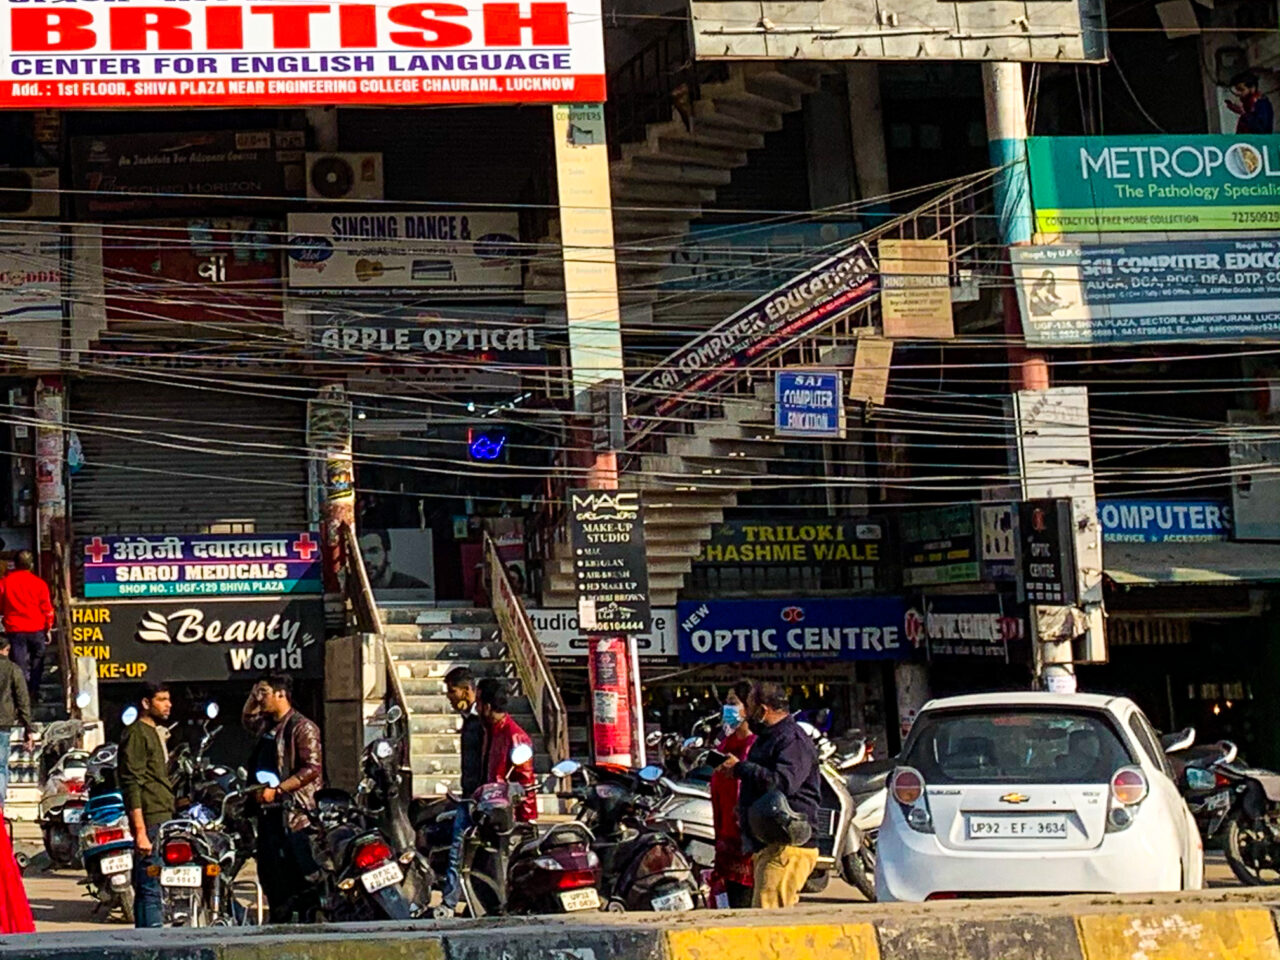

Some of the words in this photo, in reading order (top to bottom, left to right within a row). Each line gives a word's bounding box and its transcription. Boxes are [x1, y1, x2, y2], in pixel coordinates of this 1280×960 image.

[10, 2, 569, 51] BRITISH
[11, 58, 141, 75] CENTER
[154, 57, 217, 74] FOR
[231, 56, 374, 73] ENGLISH
[389, 53, 572, 71] LANGUAGE
[135, 81, 176, 95] SHIVA
[181, 81, 224, 95] PLAZA
[229, 81, 265, 94] NEAR
[269, 80, 357, 94] ENGINEERING
[360, 79, 419, 93] COLLEGE
[506, 77, 574, 91] LUCKNOW
[1114, 184, 1144, 198] The
[1148, 183, 1220, 200] Pathology
[1046, 217, 1083, 226] CONTACT
[1102, 216, 1121, 225] FREE
[1123, 216, 1147, 225] HOME
[1150, 215, 1199, 224] COLLECTION
[1081, 259, 1113, 276] SAI
[1117, 253, 1220, 273] COMPUTER
[321, 328, 410, 351] APPLE
[423, 327, 541, 351] OPTICAL
[654, 369, 679, 391] SAI
[794, 375, 821, 386] SAI
[783, 390, 833, 407] COMPUTER
[572, 493, 639, 512] MAC
[1096, 504, 1233, 530] OMPUTERS
[583, 523, 633, 533] MAKE-UP
[742, 525, 844, 542] TRILOKI
[587, 533, 630, 543] STUDIO
[114, 538, 184, 561] अंग्रेजी
[191, 538, 288, 559] दवाखाना
[813, 543, 880, 561] WALE
[1031, 543, 1051, 557] OPTIC
[116, 565, 179, 581] SAROJ
[185, 563, 287, 580] MEDICALS
[1030, 563, 1055, 578] CENTRE
[119, 584, 147, 594] SHOP
[176, 583, 217, 592] UGF-129
[220, 582, 250, 592] SHIVA
[252, 581, 284, 591] PLAZA
[72, 609, 110, 623] HAIR
[681, 604, 710, 632] NEW
[73, 627, 103, 641] SPA
[167, 608, 300, 653] Beauty
[691, 629, 778, 654] OPTIC
[787, 626, 900, 651] CENTRE
[73, 646, 110, 659] SKIN
[230, 648, 302, 670] World
